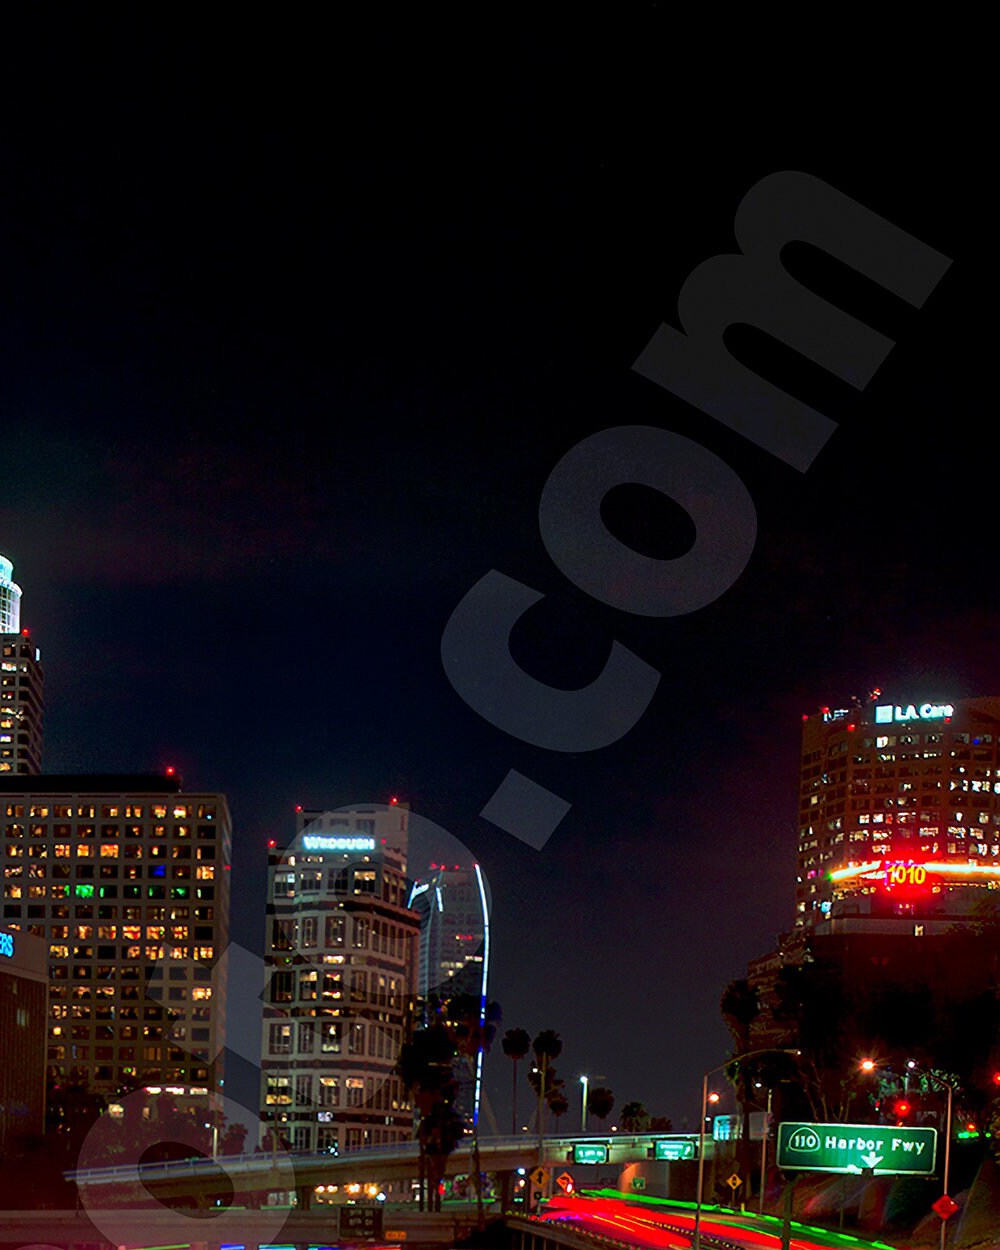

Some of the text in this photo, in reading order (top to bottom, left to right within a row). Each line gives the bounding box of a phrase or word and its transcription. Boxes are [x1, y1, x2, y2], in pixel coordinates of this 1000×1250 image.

[887, 865, 926, 884] 1010
[794, 1135, 925, 1155] 110 Harbor Fwy
